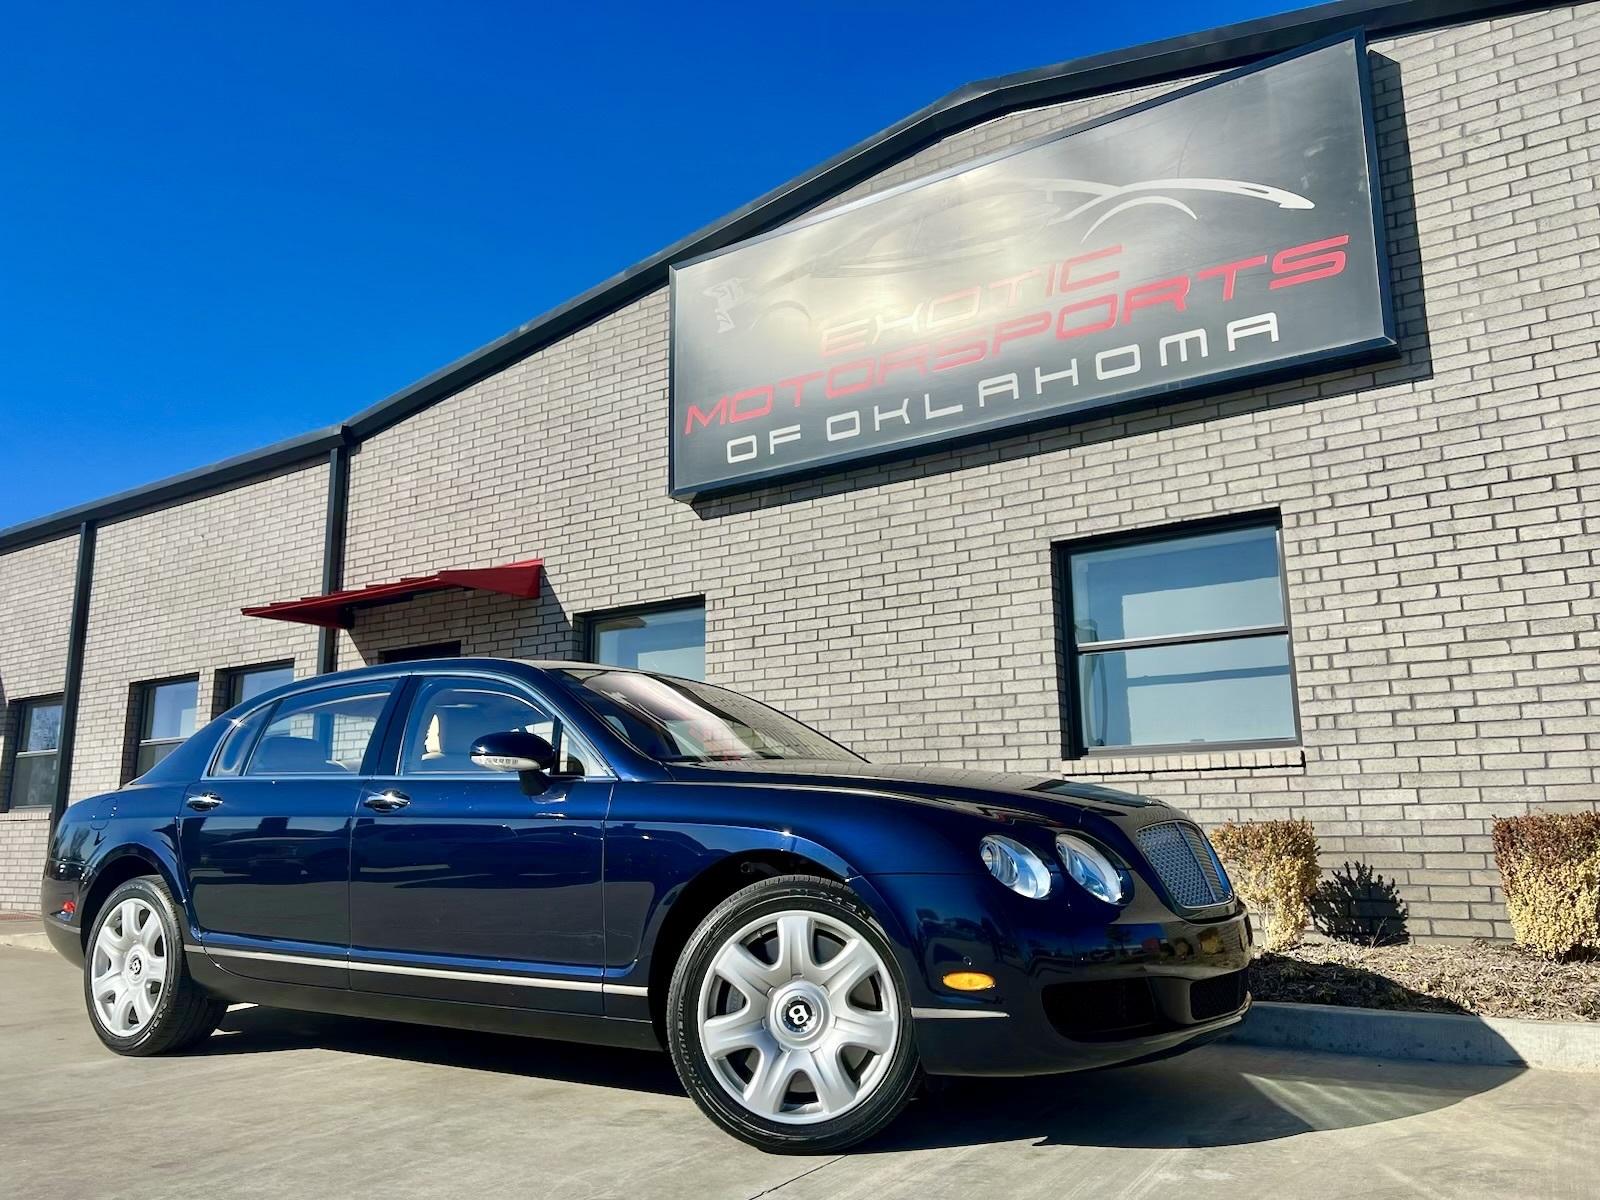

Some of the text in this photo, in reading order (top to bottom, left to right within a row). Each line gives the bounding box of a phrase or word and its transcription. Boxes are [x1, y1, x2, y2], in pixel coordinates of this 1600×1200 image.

[684, 234, 1349, 435] MOTORSPORTS
[820, 244, 1123, 358] EXOTIC
[727, 311, 1279, 464] OF OKLAHOMA
